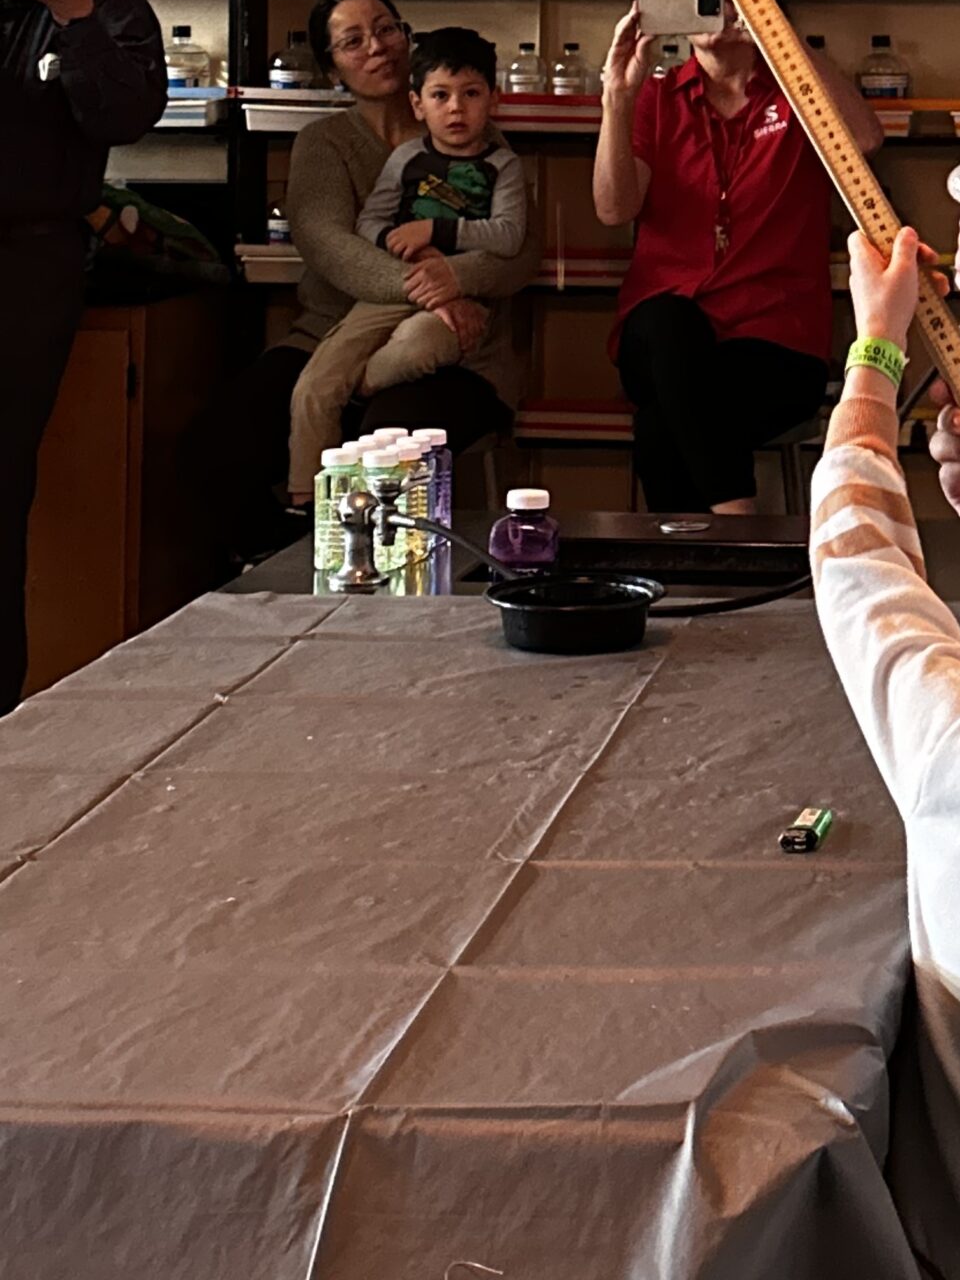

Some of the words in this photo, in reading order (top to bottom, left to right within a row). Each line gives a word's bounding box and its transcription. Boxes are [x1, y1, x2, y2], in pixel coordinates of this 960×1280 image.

[799, 83, 813, 96] 50
[753, 120, 788, 139] SIERRA
[863, 197, 876, 210] 40
[930, 317, 944, 331] 30
